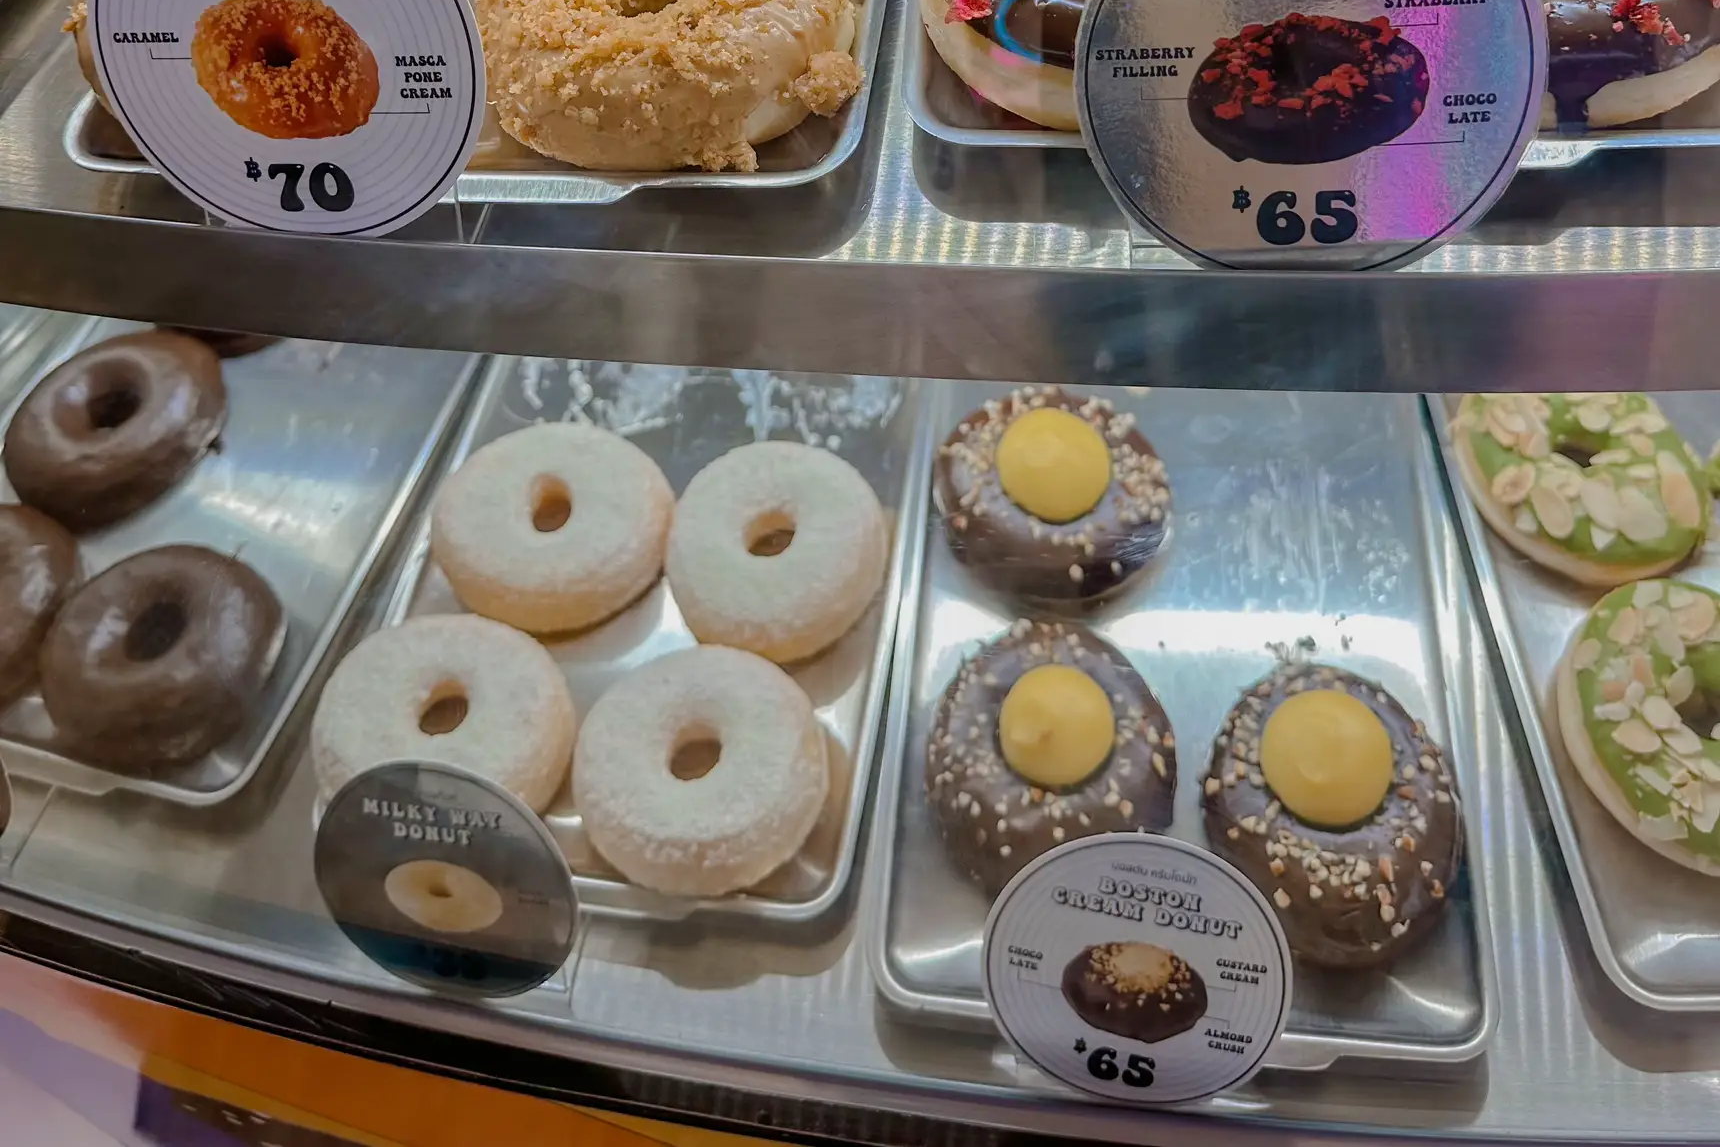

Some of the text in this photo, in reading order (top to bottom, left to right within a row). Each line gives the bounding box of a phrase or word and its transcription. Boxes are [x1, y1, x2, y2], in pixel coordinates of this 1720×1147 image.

[113, 31, 180, 44] CARAMEL
[395, 55, 446, 67] MASCA
[1095, 46, 1196, 61] STRABERRY
[404, 71, 443, 83] PONE
[1112, 64, 1179, 78] FILLING
[400, 87, 453, 99] CREAM
[1442, 93, 1498, 107] CHOCO
[1447, 110, 1492, 124] LATE
[362, 797, 502, 829] MILKY WAY
[393, 821, 473, 846] DONUT
[1098, 875, 1202, 912] BOSTON
[1051, 886, 1243, 939] CREAM DONUT
[1008, 945, 1044, 961] CHOCO
[1009, 956, 1039, 971] LATE
[1216, 957, 1268, 974] CUSTARD
[1219, 970, 1260, 985] CREAM
[1204, 1028, 1253, 1044] ALMOND
[1208, 1039, 1245, 1054] CRUSH
